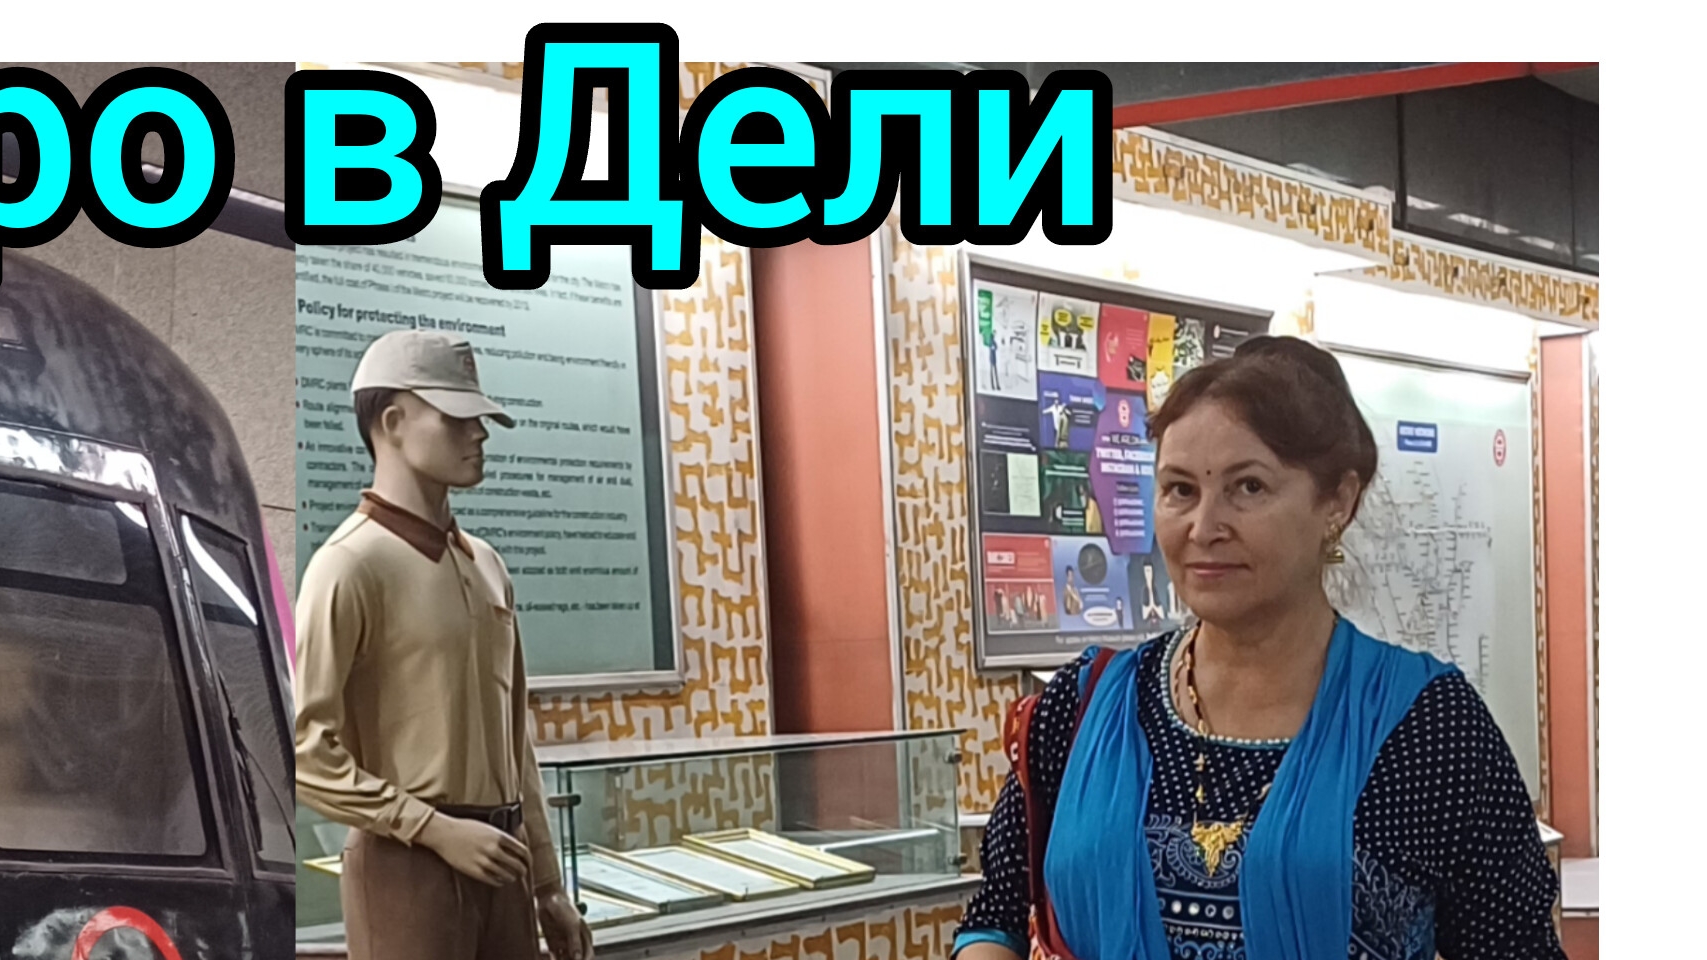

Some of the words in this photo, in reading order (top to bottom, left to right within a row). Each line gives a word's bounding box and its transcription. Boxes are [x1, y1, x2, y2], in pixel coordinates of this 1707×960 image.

[297, 297, 335, 320] Policy
[337, 302, 354, 319] for
[355, 307, 416, 330] protecting
[418, 313, 436, 329] the
[438, 316, 506, 338] environment
